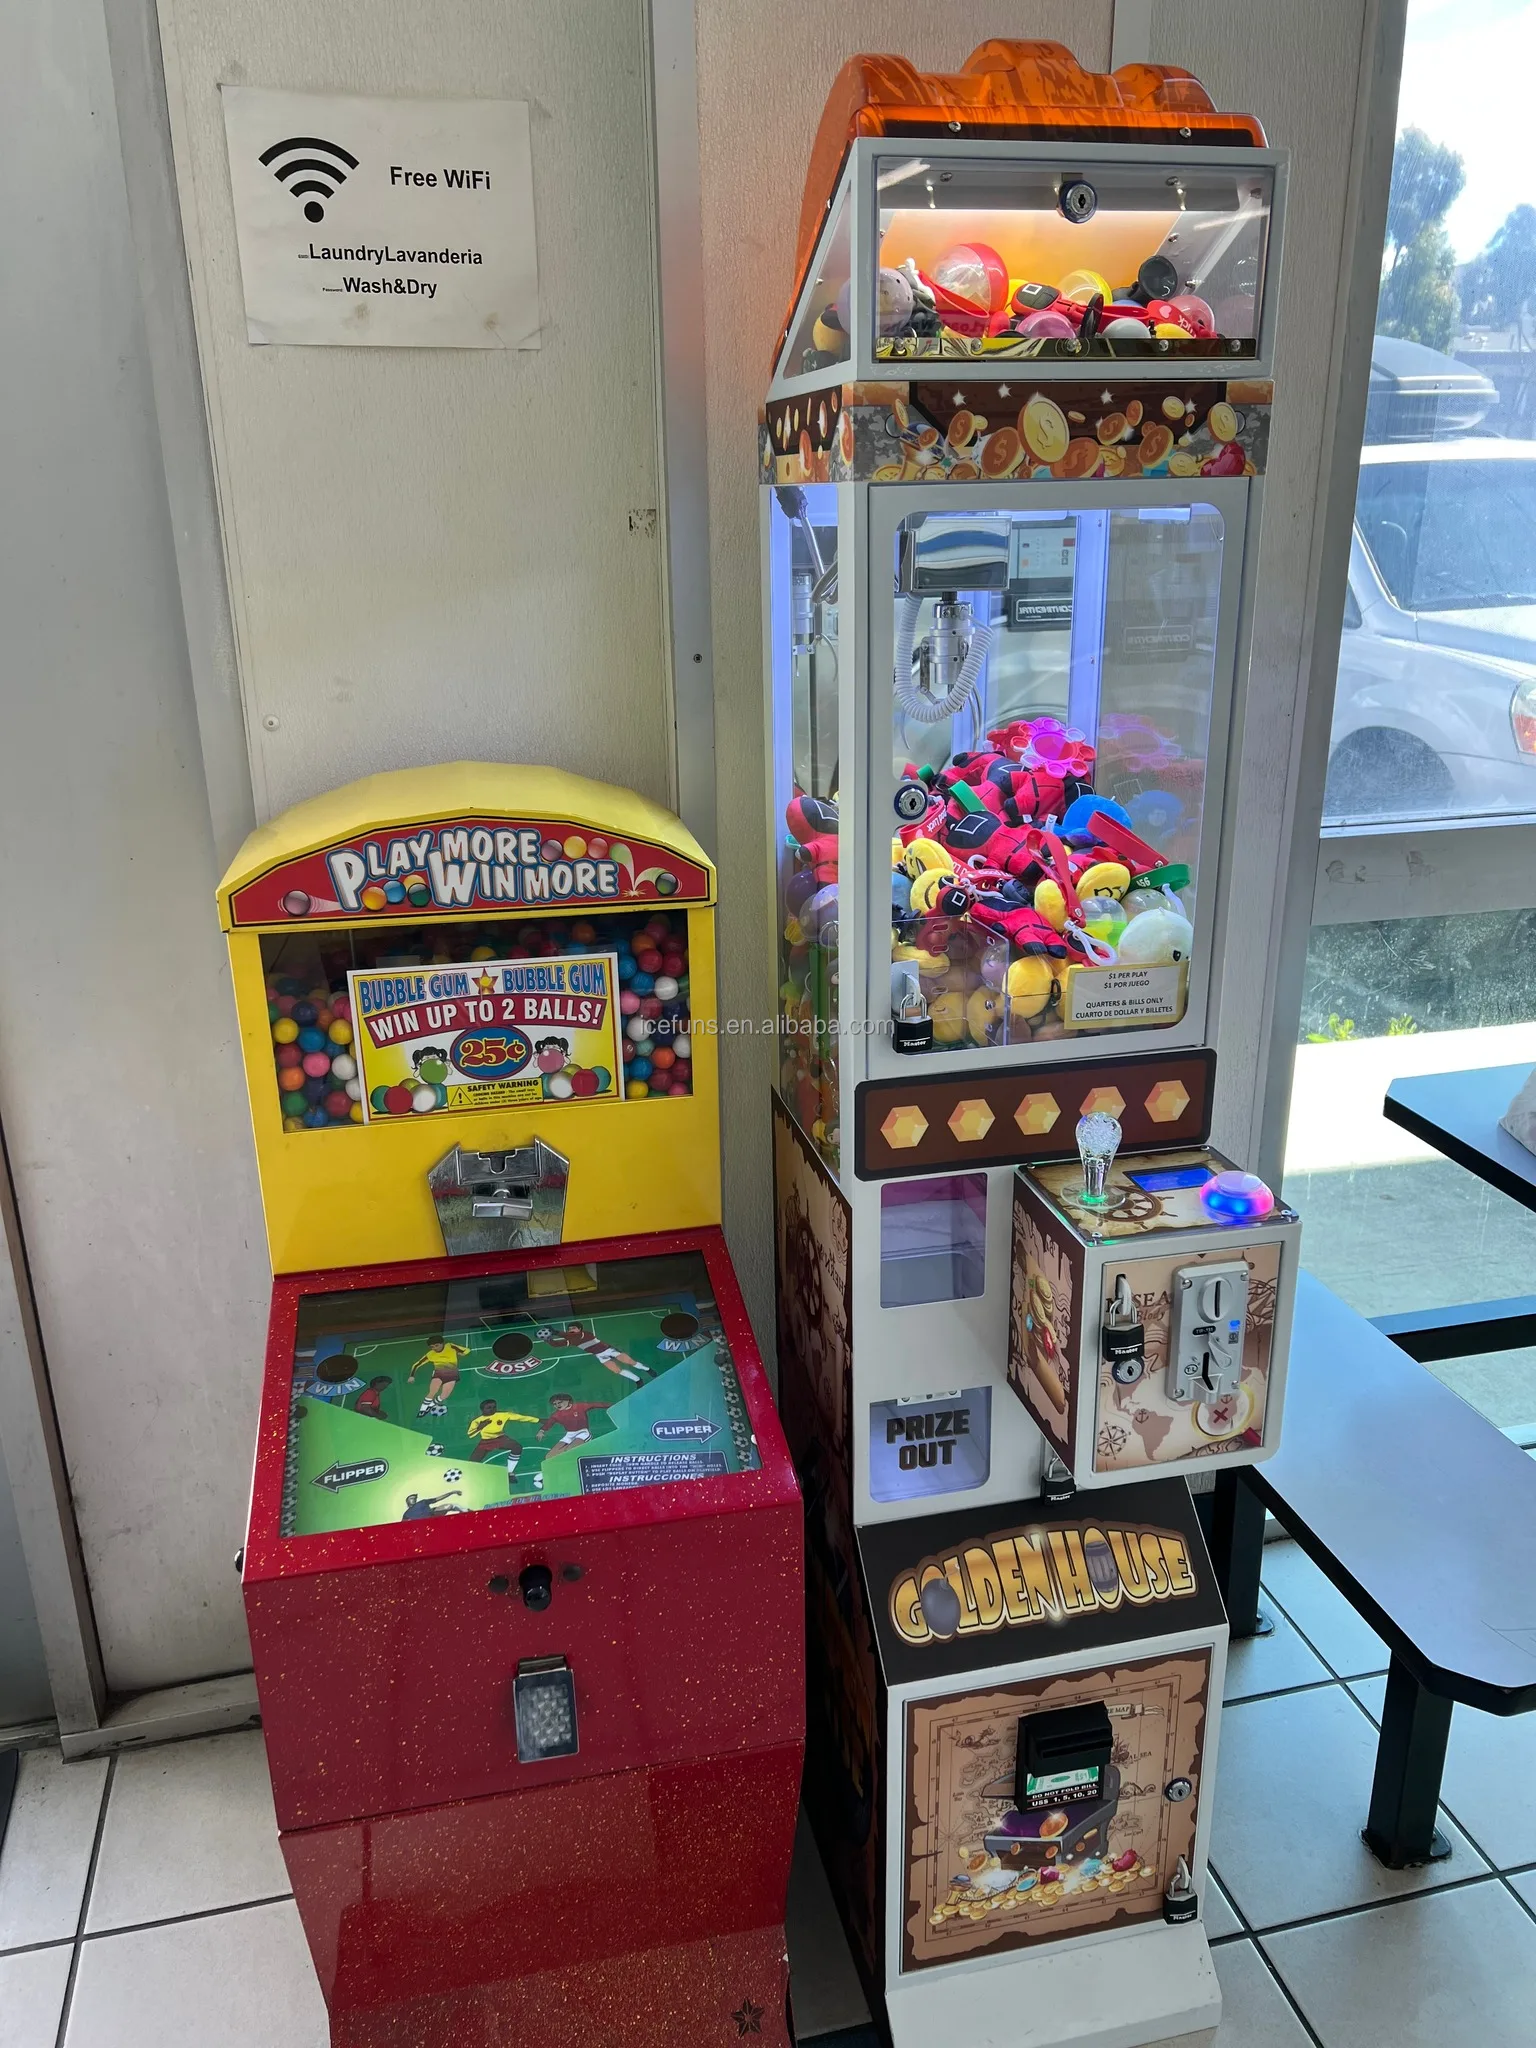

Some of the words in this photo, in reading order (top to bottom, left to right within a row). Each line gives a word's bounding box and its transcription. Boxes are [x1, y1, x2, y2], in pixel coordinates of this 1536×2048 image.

[389, 166, 438, 188] Free
[443, 168, 492, 191] WiFi
[309, 243, 483, 266] LaundryLavanderia
[342, 277, 437, 299] Wash&Dry
[327, 831, 432, 911] PLAY
[441, 829, 542, 865] MORE
[428, 849, 519, 907] WIN
[522, 860, 619, 904] MORE
[1108, 972, 1116, 980] $1
[357, 975, 427, 1015] BUBBLE
[428, 972, 471, 998] GUM
[501, 964, 566, 993] BUBBLE
[567, 962, 607, 996] GUM
[1075, 1011, 1103, 1019] CUARTO
[1114, 1008, 1139, 1016] DOLLAR
[1145, 1006, 1173, 1014] BILLETES
[1086, 1000, 1120, 1009] QUARTERS
[369, 1015, 420, 1042] WIN
[426, 1003, 458, 1029] UP
[464, 999, 495, 1024] TO
[501, 998, 516, 1020] 2
[524, 997, 603, 1025] BALLS!
[459, 1037, 527, 1067] 25¢
[467, 1083, 496, 1092] SAFETY
[497, 1080, 539, 1089] WARNING
[1132, 1290, 1171, 1309] SEA
[665, 1334, 706, 1351] WIN
[489, 1357, 539, 1374] LOSE
[315, 1376, 360, 1395] WIN
[656, 1425, 713, 1435] FLIPPER
[886, 1408, 971, 1445] PRIZE
[610, 1453, 697, 1464] INSTRUCTIONS
[898, 1438, 957, 1471] OUT
[323, 1464, 385, 1484] FLIPPER
[609, 1472, 705, 1483] INSTRUCCIONES
